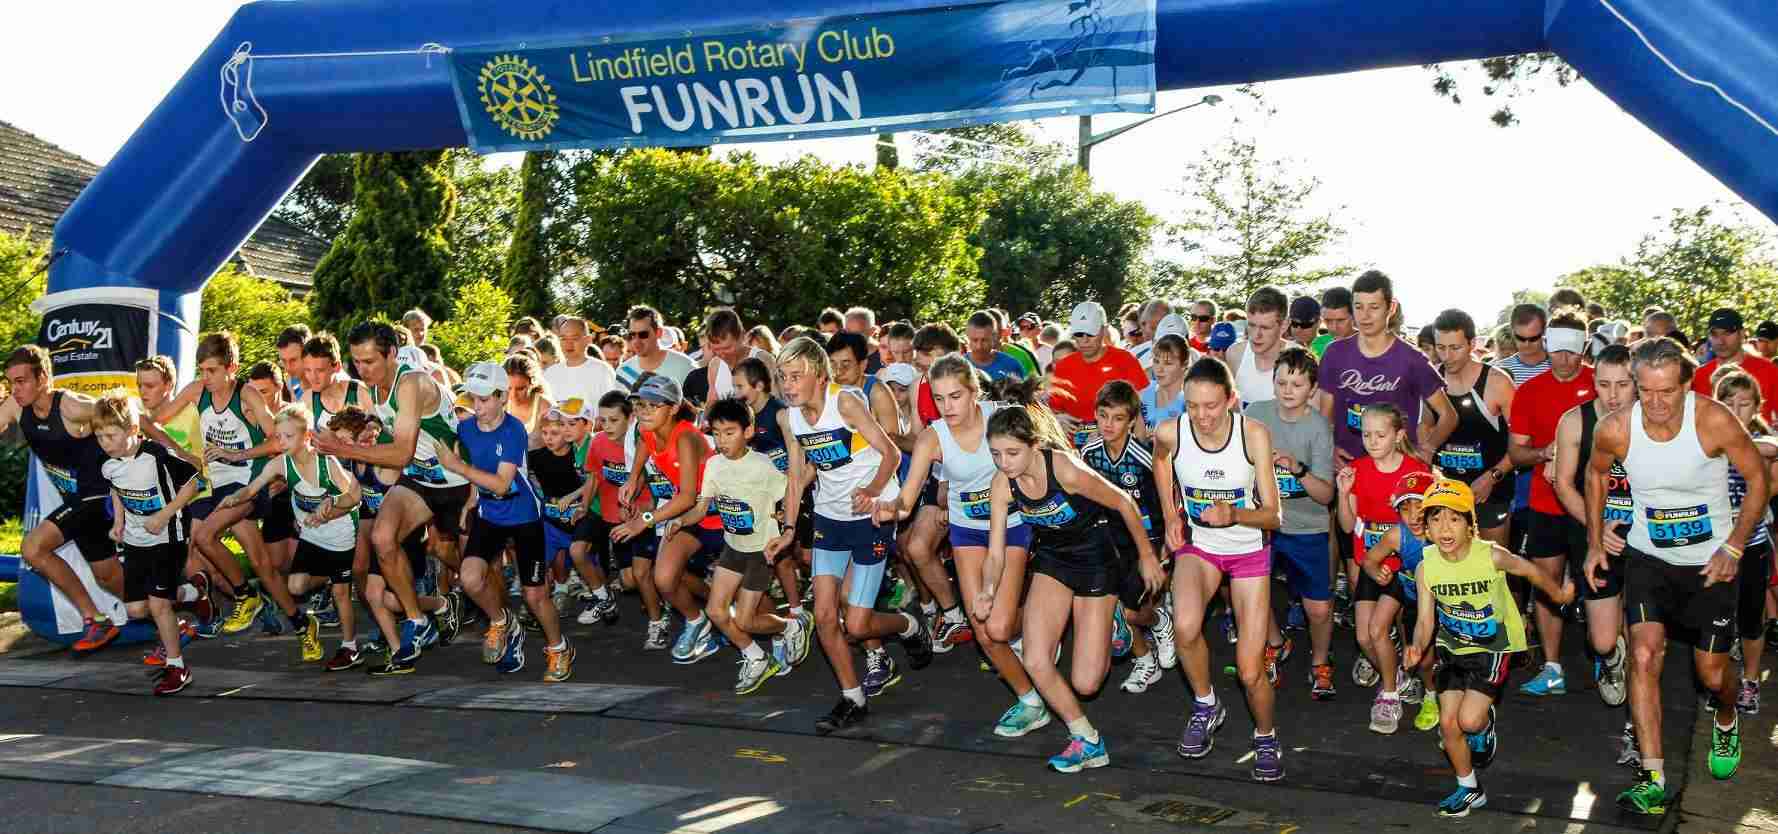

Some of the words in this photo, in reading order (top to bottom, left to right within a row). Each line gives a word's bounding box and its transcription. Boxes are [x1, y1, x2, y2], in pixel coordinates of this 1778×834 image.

[569, 44, 696, 83] Lindfield
[703, 39, 806, 73] Rotary
[816, 26, 895, 63] Club
[620, 70, 861, 134] FUNRUN
[47, 319, 101, 342] Century
[92, 327, 113, 349] 21
[70, 351, 98, 362] Estate
[1656, 519, 1704, 538] 5139
